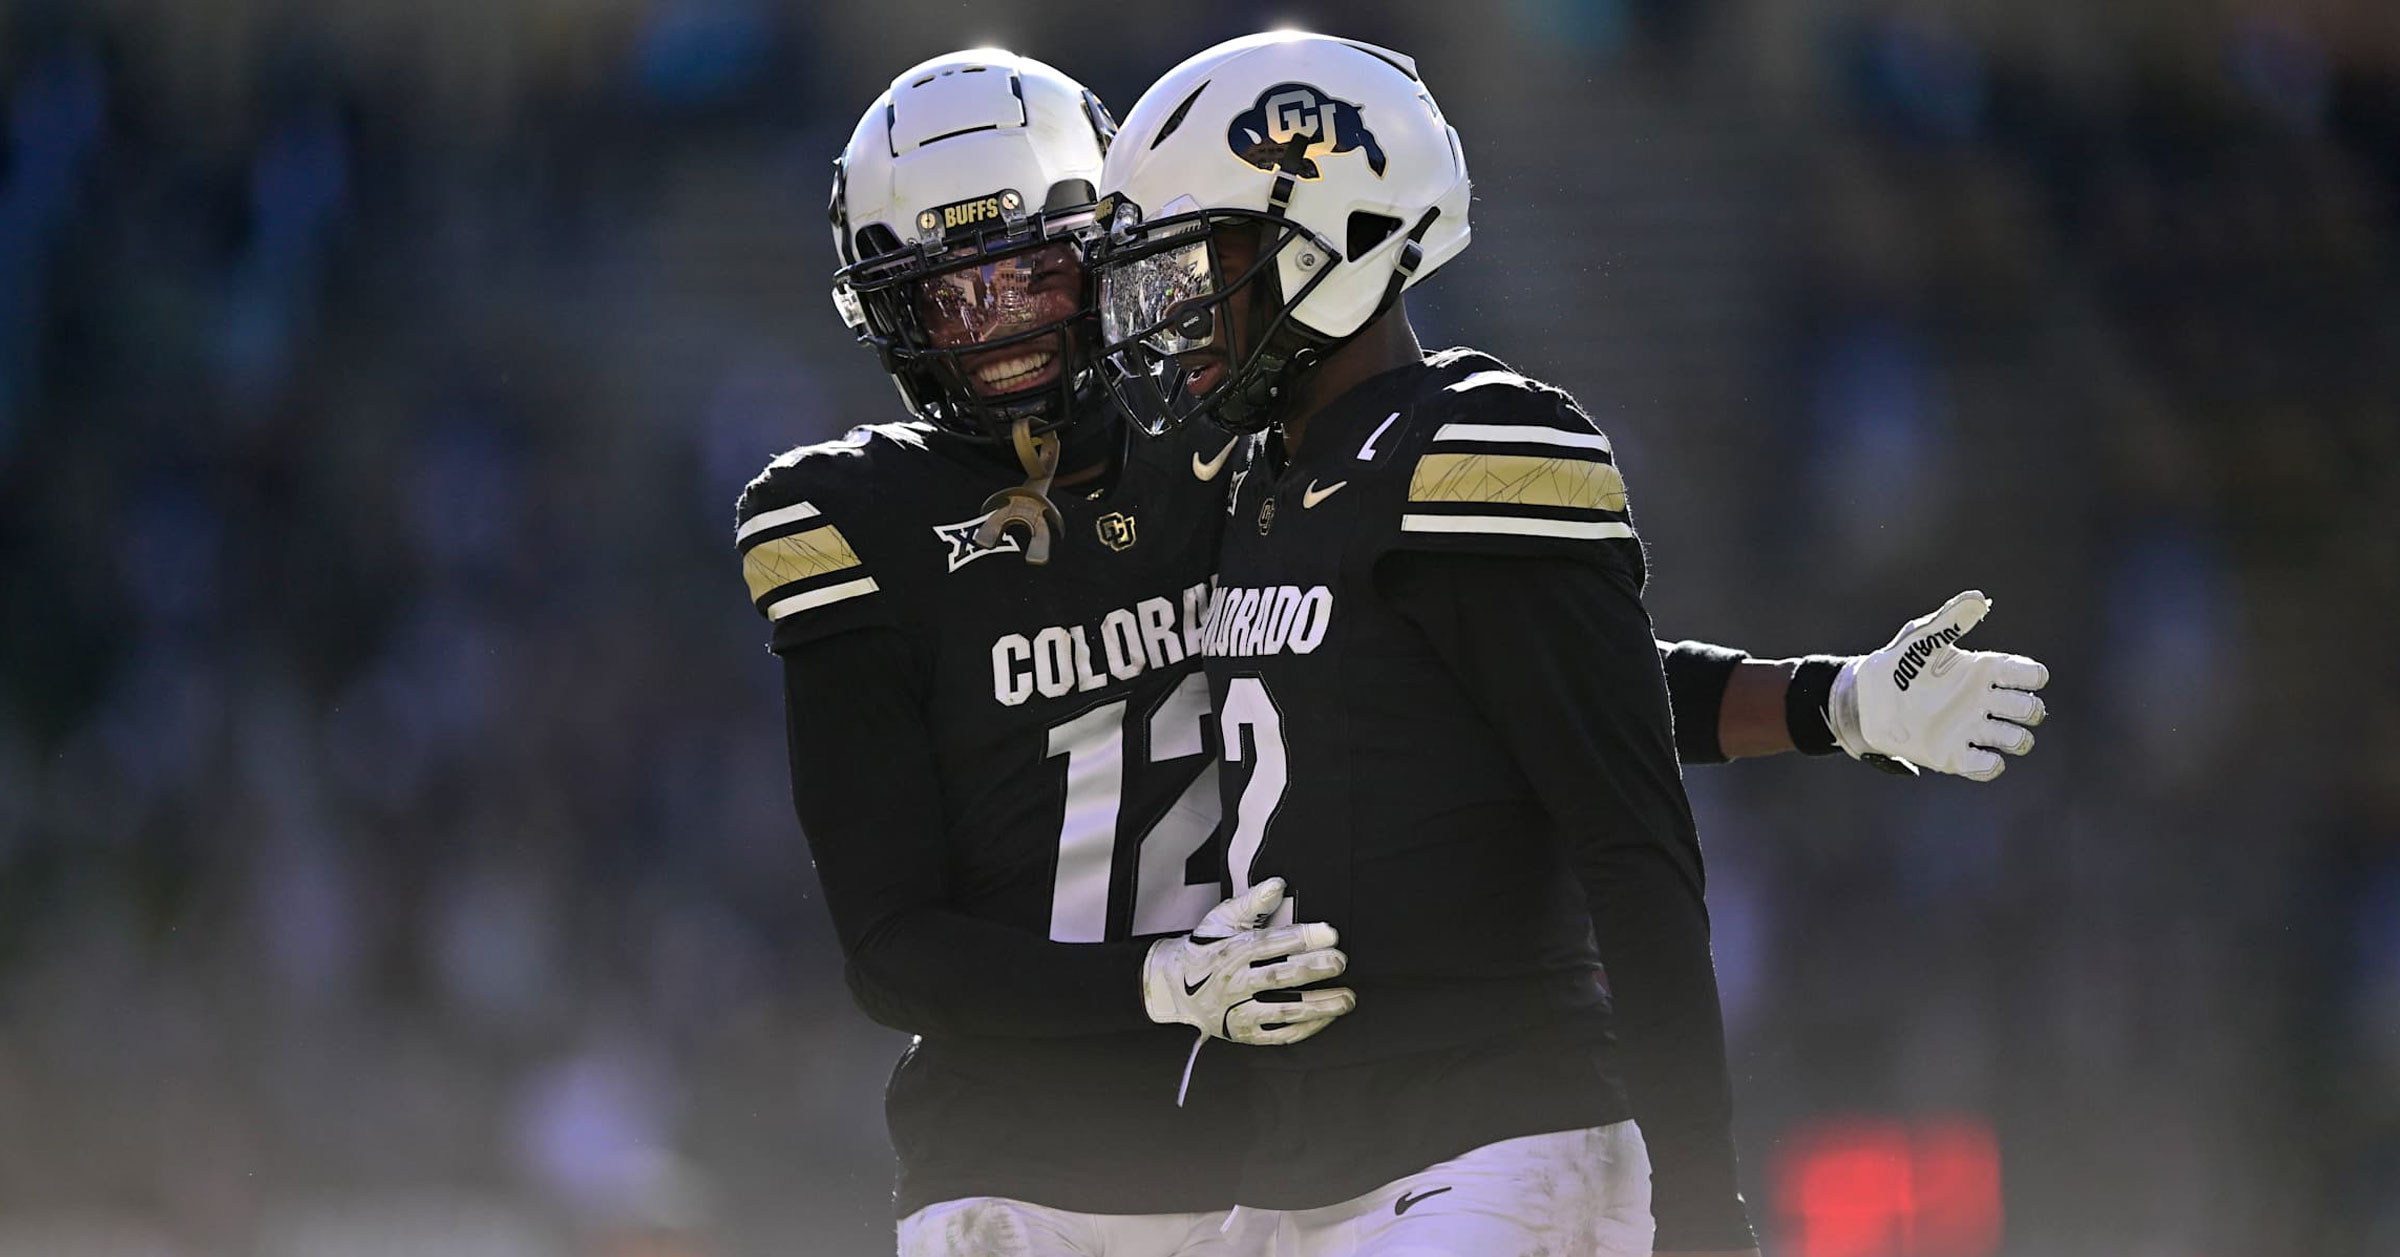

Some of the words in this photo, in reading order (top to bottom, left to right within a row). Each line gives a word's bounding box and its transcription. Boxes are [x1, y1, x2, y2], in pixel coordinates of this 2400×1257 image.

[944, 197, 998, 228] BUFFS
[992, 574, 1212, 706] COLORA
[1046, 671, 1222, 943] 12
[1220, 677, 1295, 926] 2
